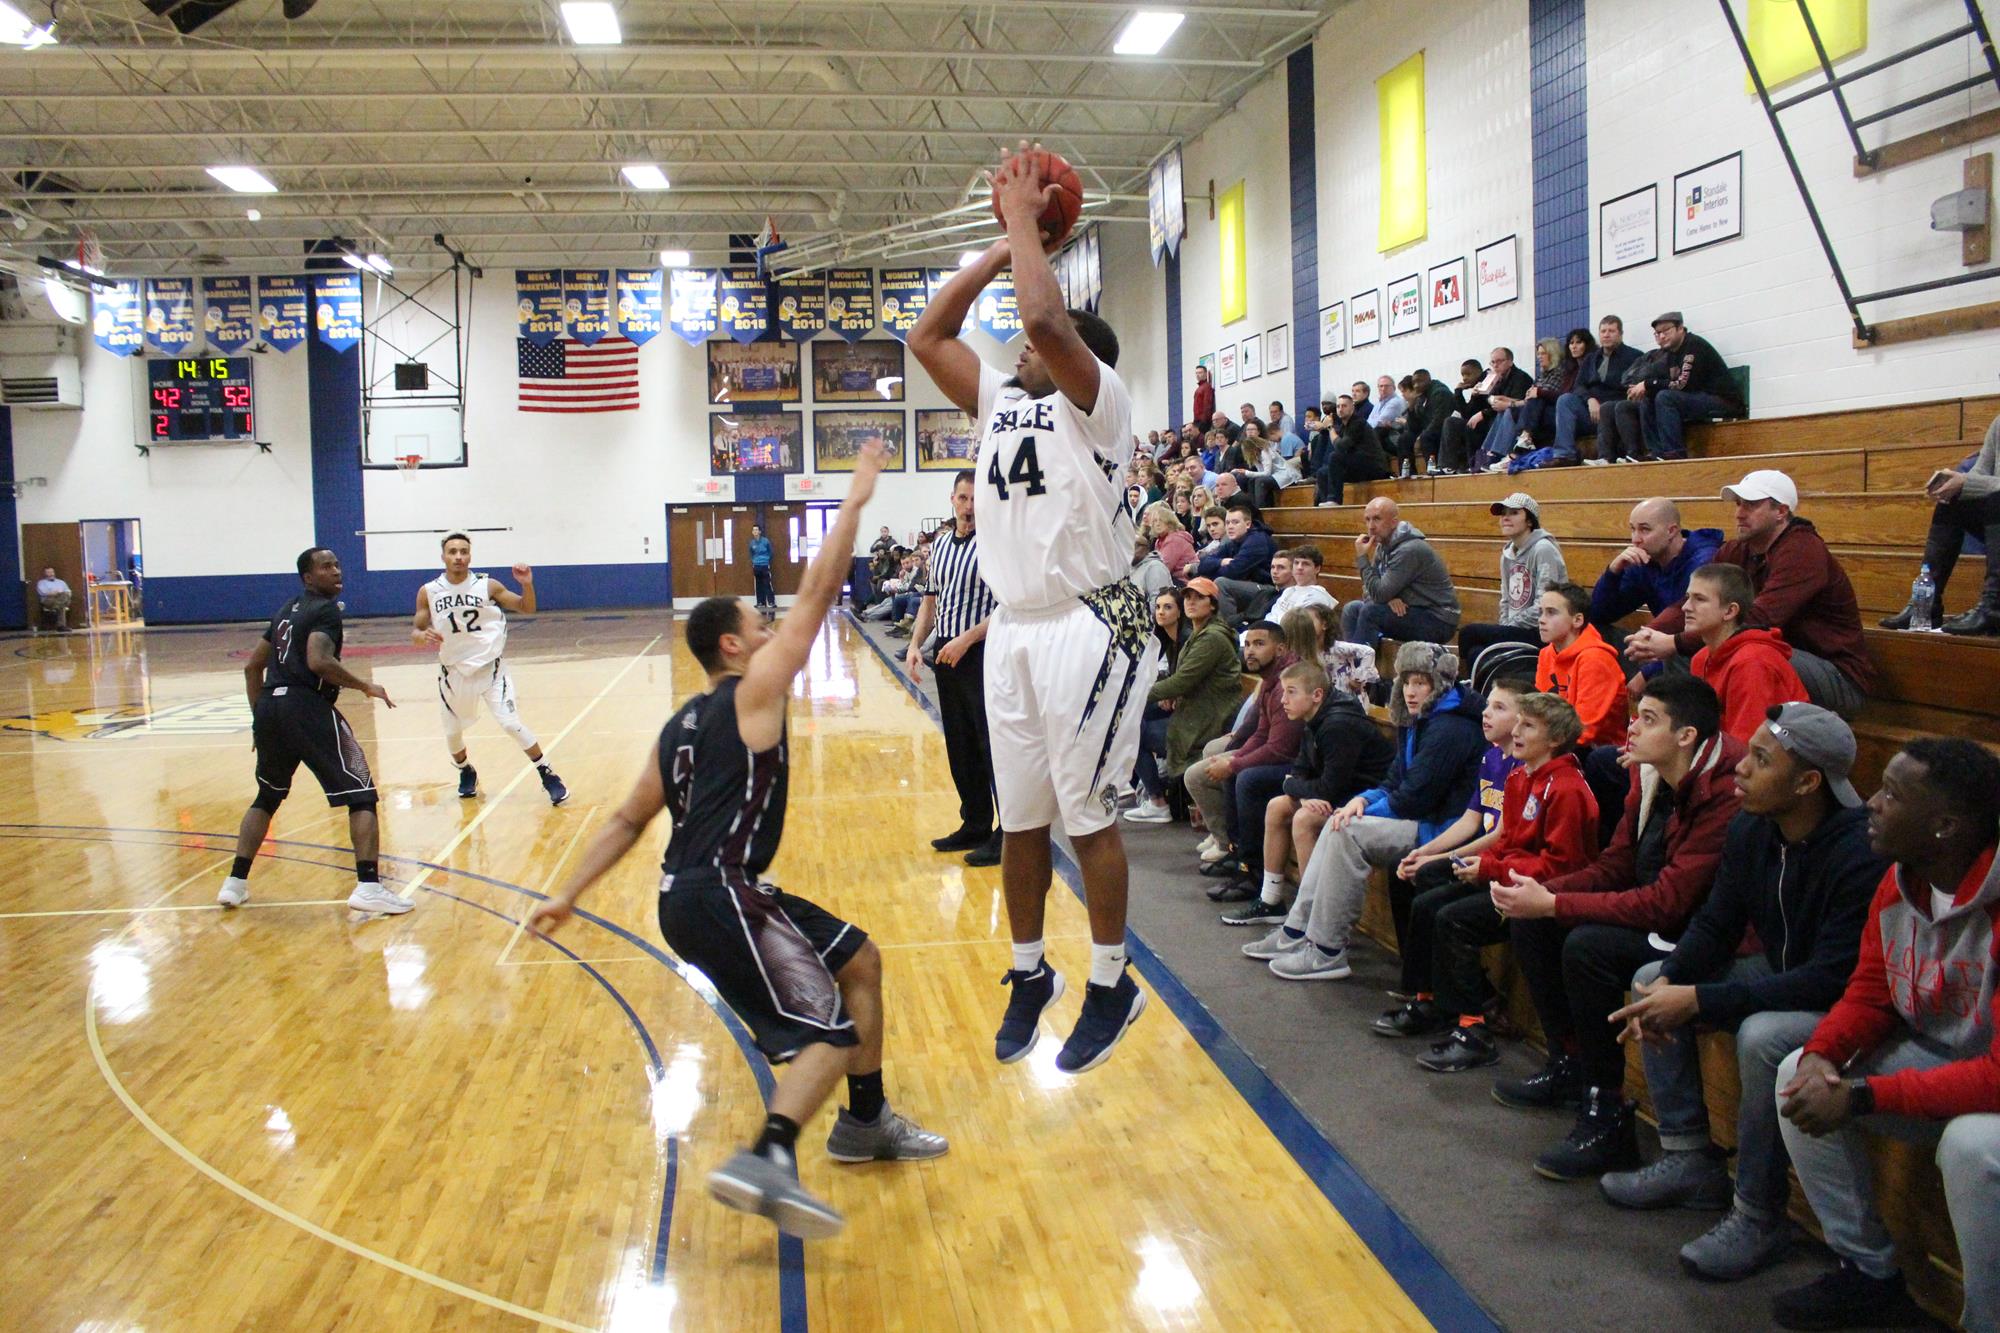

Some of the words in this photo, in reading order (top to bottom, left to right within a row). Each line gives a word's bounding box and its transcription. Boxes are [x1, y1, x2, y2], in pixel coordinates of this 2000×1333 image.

[1703, 196, 1729, 211] Interiors
[886, 271, 920, 280] WOMEN'S
[722, 281, 766, 289] BASKETBALL
[829, 281, 872, 289] BASKETBALL
[881, 281, 925, 290] BASKETBALL
[1402, 306, 1418, 317] PIZZA
[577, 322, 609, 333] 2014
[628, 321, 660, 332] 2014
[735, 319, 767, 330] 2015
[792, 319, 825, 330] 2015
[896, 320, 918, 330] 201
[160, 332, 194, 342] 2010
[218, 329, 250, 341] 2011
[273, 328, 306, 339] 2011
[178, 360, 197, 379] 14
[210, 359, 228, 379] 15
[154, 388, 180, 408] 42
[224, 386, 250, 406] 52
[156, 415, 169, 435] 2
[988, 437, 1047, 501] 44
[435, 594, 484, 613] GRACE
[448, 609, 482, 634] 12
